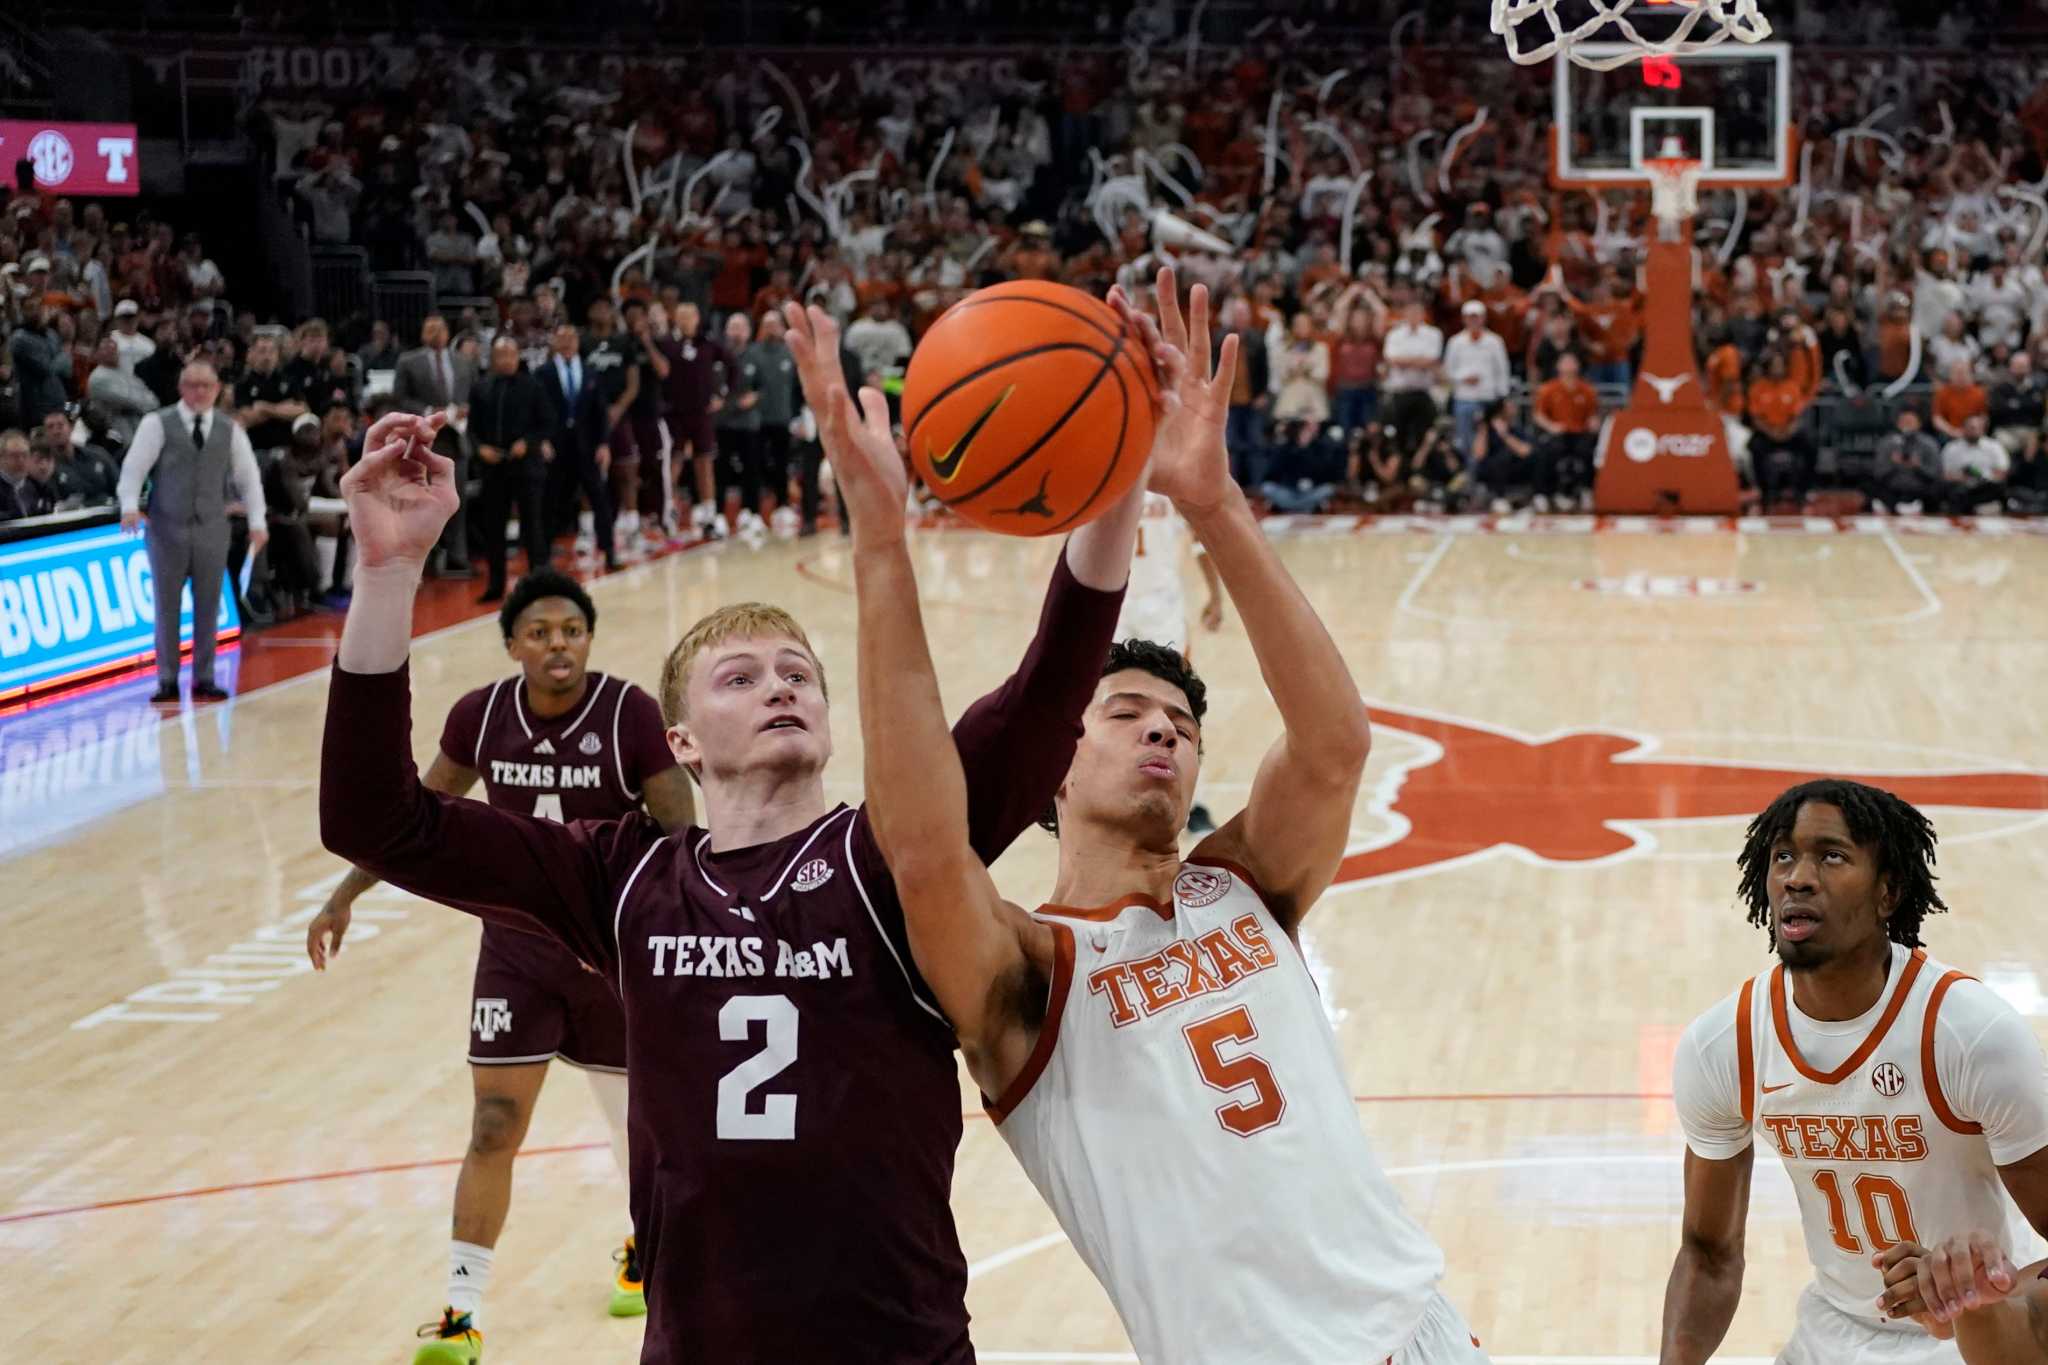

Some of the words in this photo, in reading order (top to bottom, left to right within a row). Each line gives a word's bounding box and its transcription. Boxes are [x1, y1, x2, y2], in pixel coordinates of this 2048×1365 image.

[97, 137, 133, 183] T
[0, 566, 93, 658] BUD
[87, 549, 193, 634] LIG
[491, 760, 555, 787] TEXAS
[560, 765, 601, 788] A&M
[648, 936, 765, 977] TEXAS
[775, 938, 853, 979] A&M
[1087, 912, 1279, 1029] TEXAS
[716, 994, 799, 1140] 2
[1182, 1004, 1287, 1138] 5
[1873, 1063, 1904, 1096] SEC
[1761, 1115, 1929, 1162] TEXAS
[1812, 1169, 1922, 1255] 10
